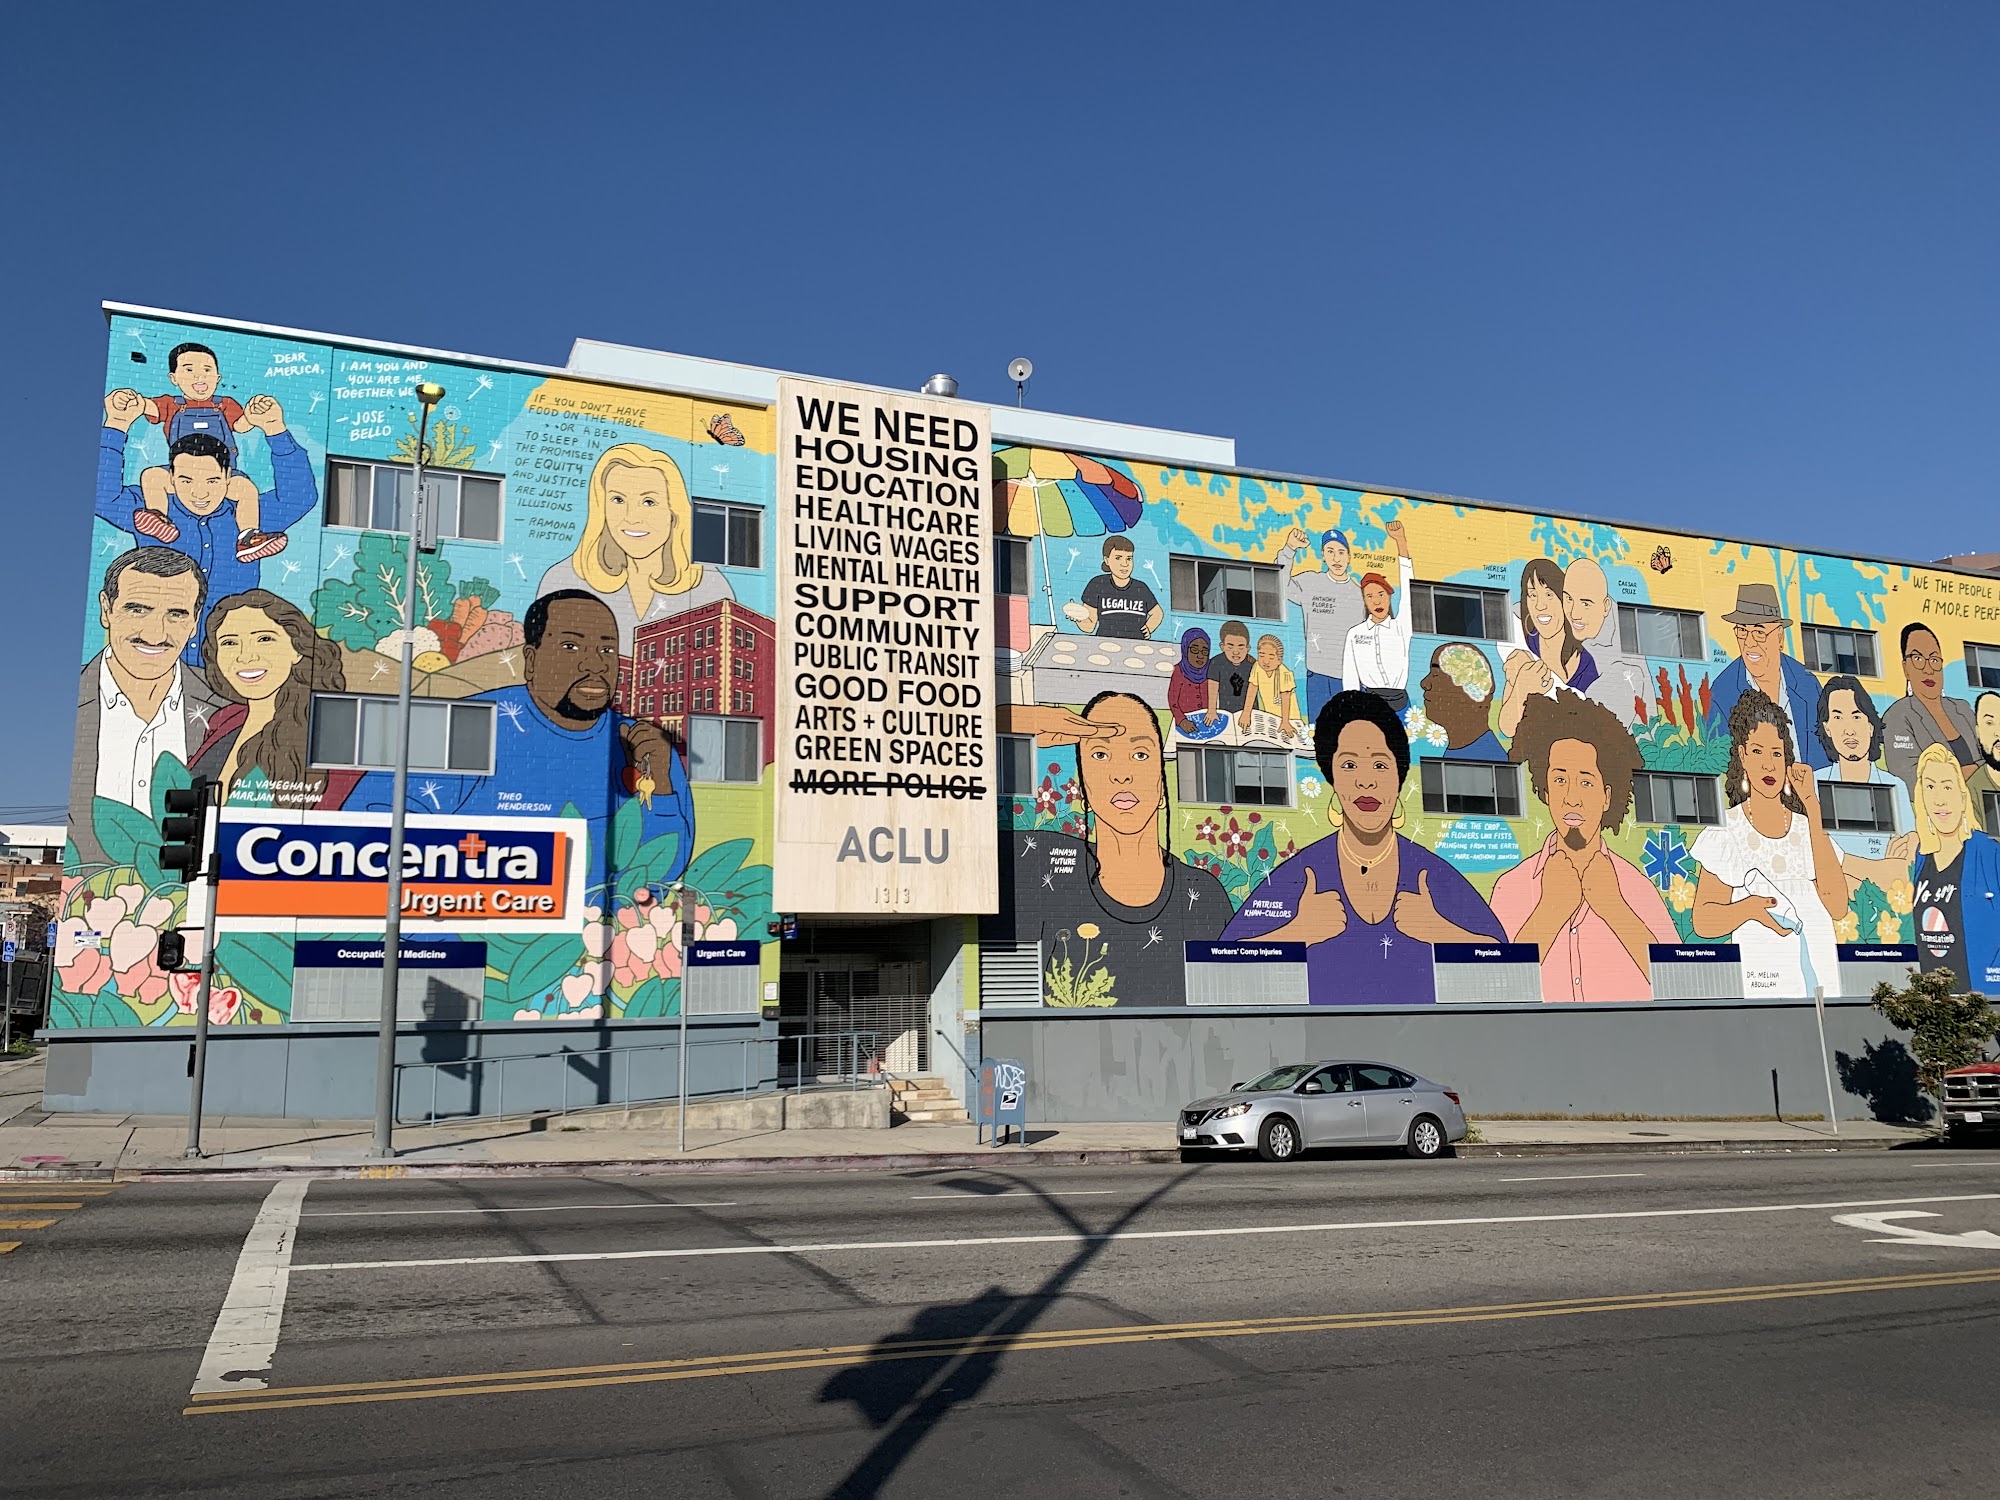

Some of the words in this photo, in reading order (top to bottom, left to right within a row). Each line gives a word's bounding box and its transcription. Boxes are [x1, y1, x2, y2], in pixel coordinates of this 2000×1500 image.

[273, 352, 307, 364] DEAR
[264, 363, 325, 378] AMERICA,
[341, 362, 345, 372] I
[350, 361, 371, 372] AM
[375, 361, 399, 373] YOU
[402, 360, 428, 370] AND
[348, 375, 374, 386] YOU
[377, 375, 400, 384] ARE
[333, 386, 394, 399] TOGETHER
[399, 387, 414, 397] WE
[534, 393, 546, 403] IF
[554, 396, 575, 408] YOU
[580, 401, 612, 413] DON'T
[617, 406, 647, 418] HAVE
[351, 410, 385, 426] JOSE
[528, 405, 559, 417] FOOD
[563, 411, 579, 421] ON
[585, 412, 607, 424] THE
[612, 416, 645, 429] TABLE
[796, 395, 860, 437] WE
[874, 406, 979, 453] NEED
[350, 425, 391, 442] BELLO
[560, 422, 575, 433] OR
[583, 427, 590, 435] A
[594, 427, 618, 439] BED
[525, 430, 539, 441] TO
[541, 433, 579, 447] SLEEP
[515, 442, 535, 454] THE
[539, 445, 594, 461] PROMISES
[795, 434, 979, 482] HOUSING
[514, 457, 530, 467] OF
[534, 458, 583, 475] EQUITY
[512, 469, 533, 480] AND
[534, 473, 587, 488] JUSTICE
[515, 485, 536, 496] ARE
[538, 488, 566, 499] JUST
[796, 464, 980, 510] EDUCATION
[517, 497, 573, 512] ILLUSIONS
[795, 493, 980, 538] HEALTHCARE
[528, 516, 576, 531] RAMONA
[528, 530, 573, 542] RIPSTON
[794, 523, 881, 556] LIVING
[889, 533, 980, 566] WAGES
[1353, 552, 1373, 560] YOUTH
[1373, 553, 1396, 563] LIBERTY
[1366, 561, 1384, 569] SQUAD
[795, 552, 889, 585] MENTAL
[896, 562, 980, 594] HEALTH
[1487, 573, 1505, 581] SMITH
[1913, 575, 1928, 590] WE
[1935, 578, 1954, 593] THE
[1958, 583, 1992, 599] PEOPLE
[794, 583, 980, 623] SUPPORT
[1101, 597, 1144, 611] LEGALIZE
[1922, 598, 1931, 613] A
[1935, 601, 1969, 618] MORE
[795, 611, 980, 651] COMMUNITY
[794, 642, 878, 672] PUBLIC
[884, 648, 980, 679] TRANSIT
[794, 672, 888, 702] GOOD
[898, 679, 981, 708] FOOD
[795, 704, 856, 732] ARTS
[882, 709, 983, 739] CULTURE
[795, 734, 881, 763] GREEN
[889, 738, 984, 768] SPACES
[233, 778, 251, 789] ALI
[793, 768, 877, 797] MORE
[886, 772, 984, 800] POLICE
[228, 790, 275, 802] MARJAN
[497, 791, 522, 801] THEO
[496, 802, 552, 812] HENDERSON
[1441, 820, 1453, 829] WE
[1455, 821, 1468, 830] ARE
[1470, 822, 1482, 830] THE
[1437, 831, 1449, 839] OUR
[1450, 831, 1480, 840] FLOWERS
[1480, 832, 1493, 840] LIKE
[1494, 832, 1512, 840] FISTS
[836, 825, 949, 865] ACLU
[1049, 847, 1077, 857] JANAYA
[1434, 841, 1467, 850] SPRINGING
[1469, 842, 1486, 850] FROM
[1500, 842, 1519, 850] EARTH
[235, 827, 538, 881] Concentra
[1050, 857, 1076, 866] FUTURE
[1053, 866, 1074, 874] KHAN
[491, 889, 554, 912] Care
[874, 887, 911, 904] 1313
[1914, 880, 1932, 907] Yo
[1252, 900, 1284, 909] PATRISSE
[1244, 909, 1292, 919] KHAN-CULLORS
[403, 949, 447, 960] Medicine
[696, 949, 726, 960] Urgent
[726, 949, 747, 958] Care
[1211, 947, 1239, 955] Workers'
[1240, 948, 1259, 957] Comp
[1259, 948, 1283, 957] Injuries
[1474, 949, 1501, 958] Physicals
[1675, 949, 1695, 958] Therapy
[1695, 949, 1716, 957] Services
[1986, 966, 2000, 975] BAMB
